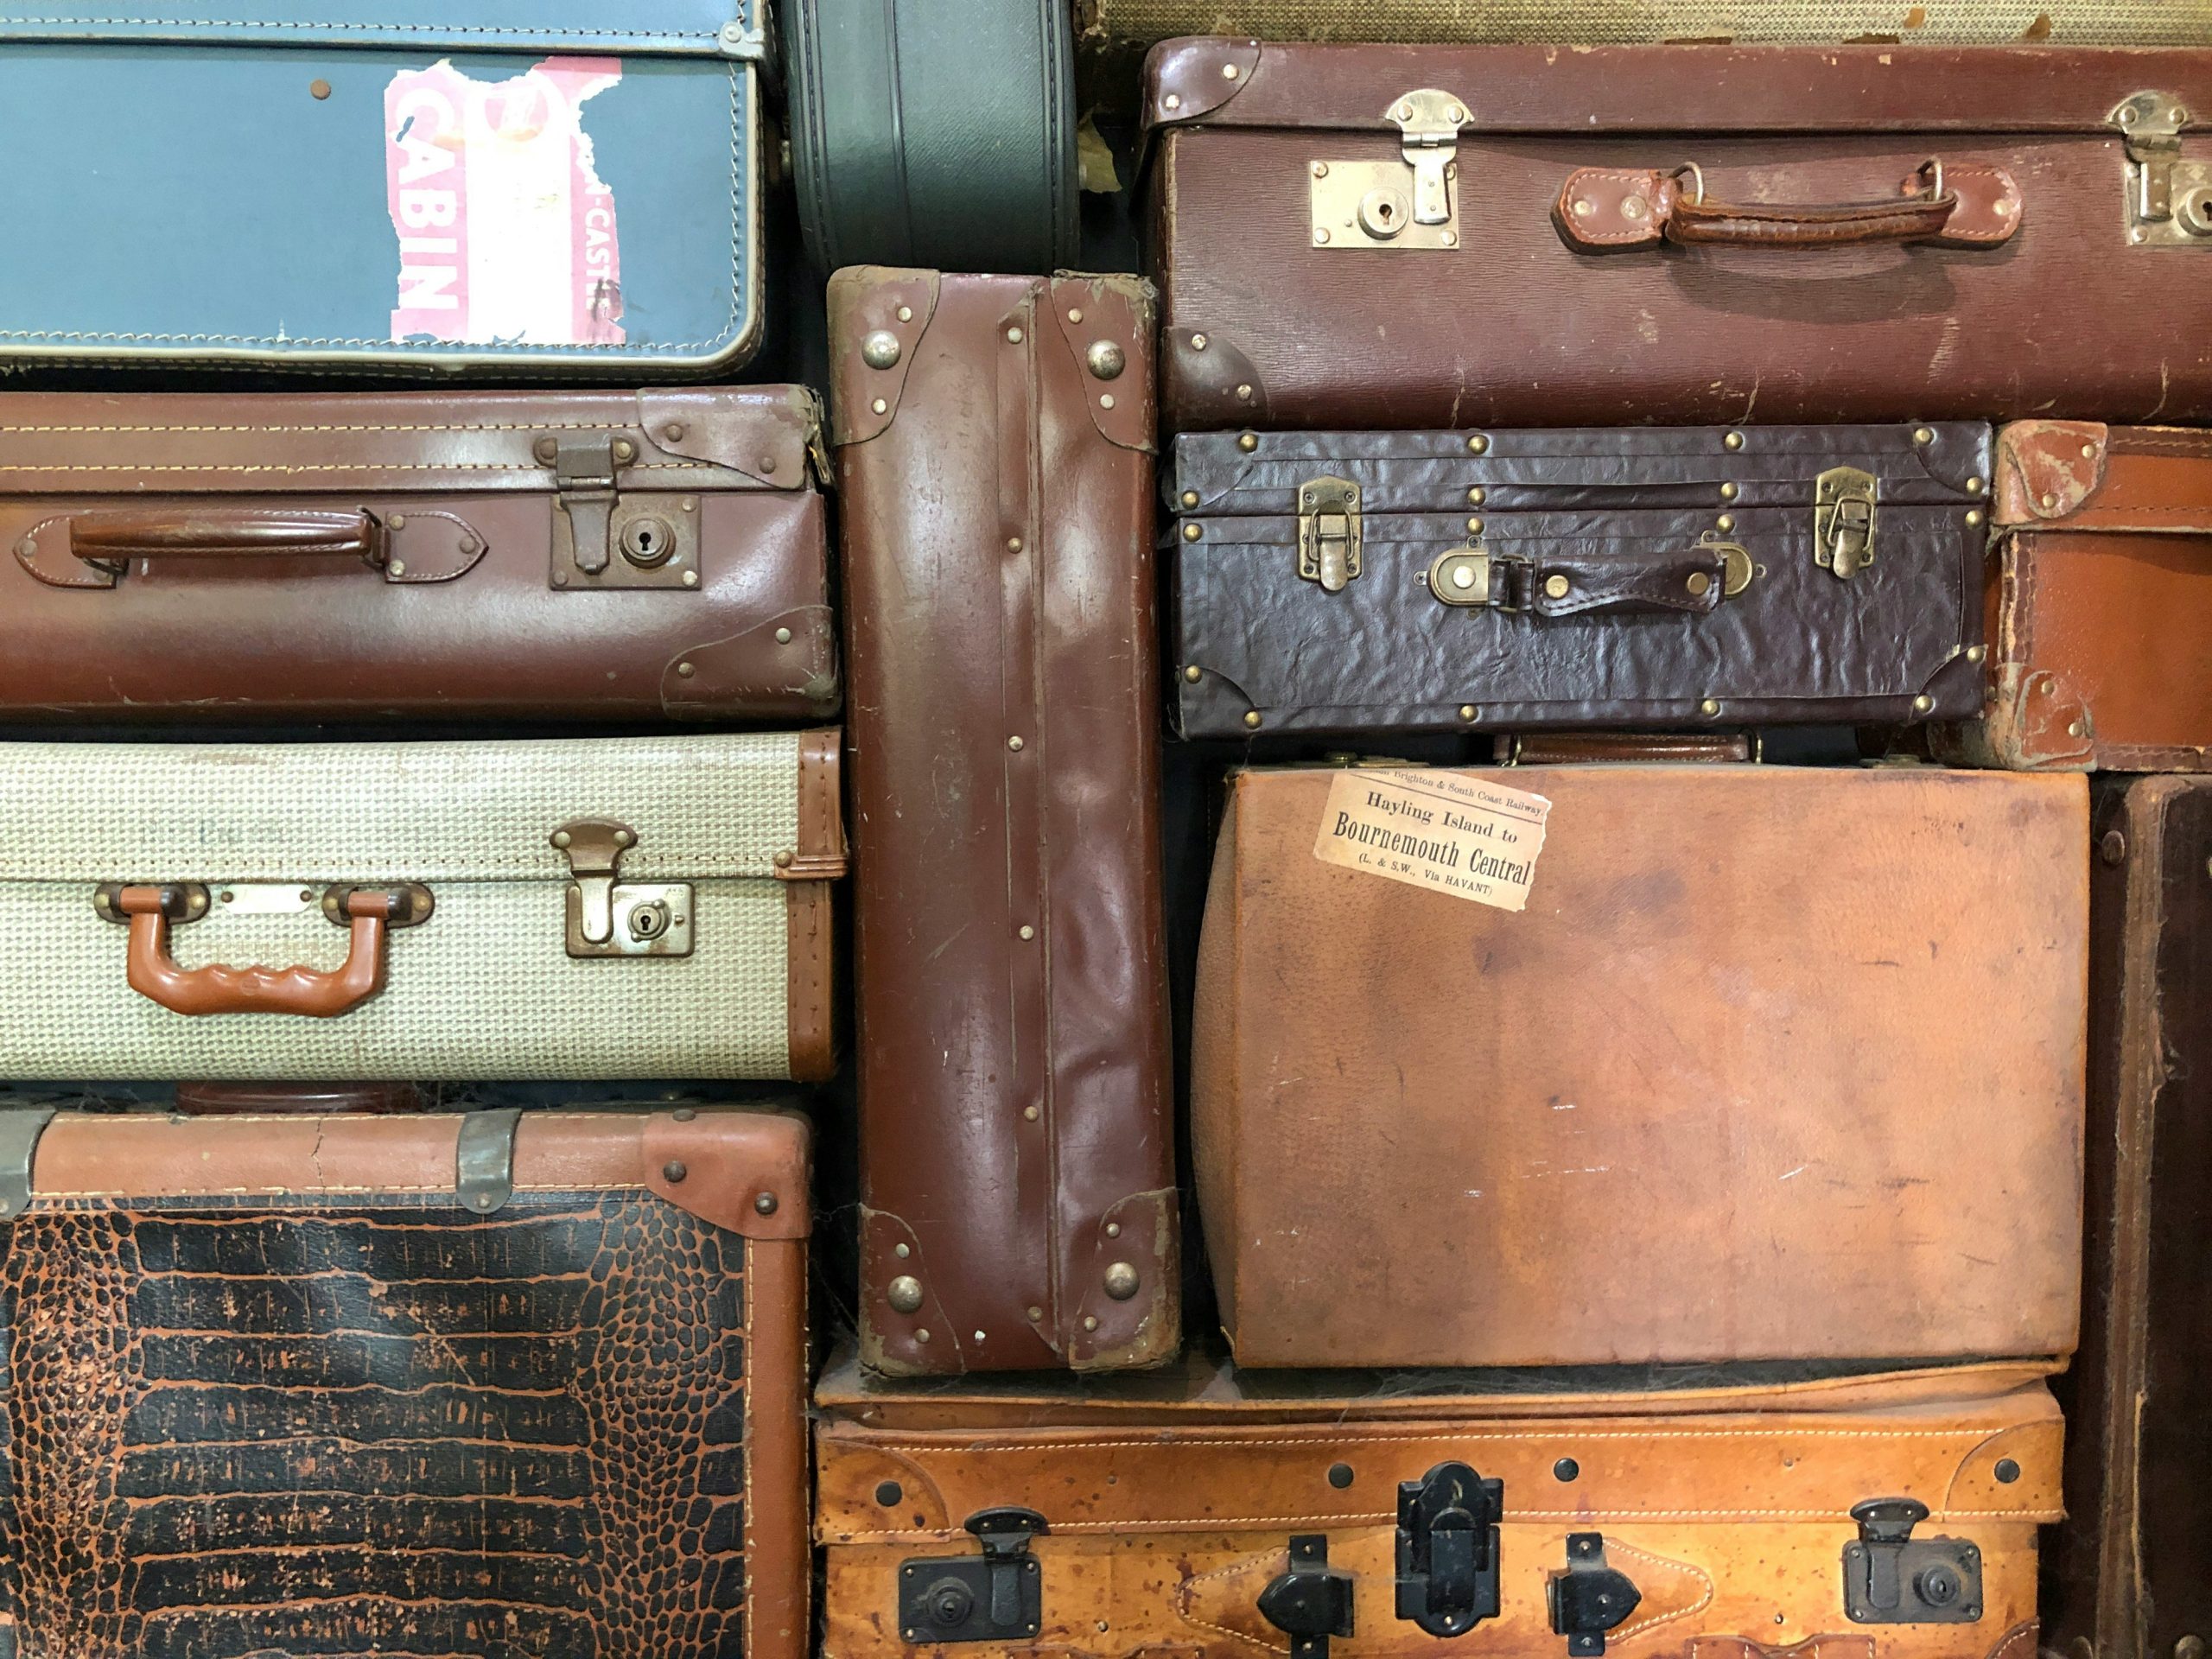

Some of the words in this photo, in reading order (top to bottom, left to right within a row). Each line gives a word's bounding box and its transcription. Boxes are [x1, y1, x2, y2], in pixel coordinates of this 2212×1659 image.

[395, 88, 459, 309] CABIN
[1394, 771, 1434, 787] Brighton
[1436, 780, 1446, 790] &
[1447, 783, 1475, 798] South
[1478, 791, 1503, 804] Coast
[1367, 791, 1434, 825] Hayling
[1441, 810, 1494, 837] Island
[1502, 829, 1518, 843] to
[1333, 810, 1460, 868] Bournemouth
[1470, 848, 1532, 886] Central
[1358, 852, 1372, 864] (L.
[1377, 857, 1387, 868] &
[1424, 869, 1440, 881] Via
[1445, 874, 1494, 897] HAVANT)
